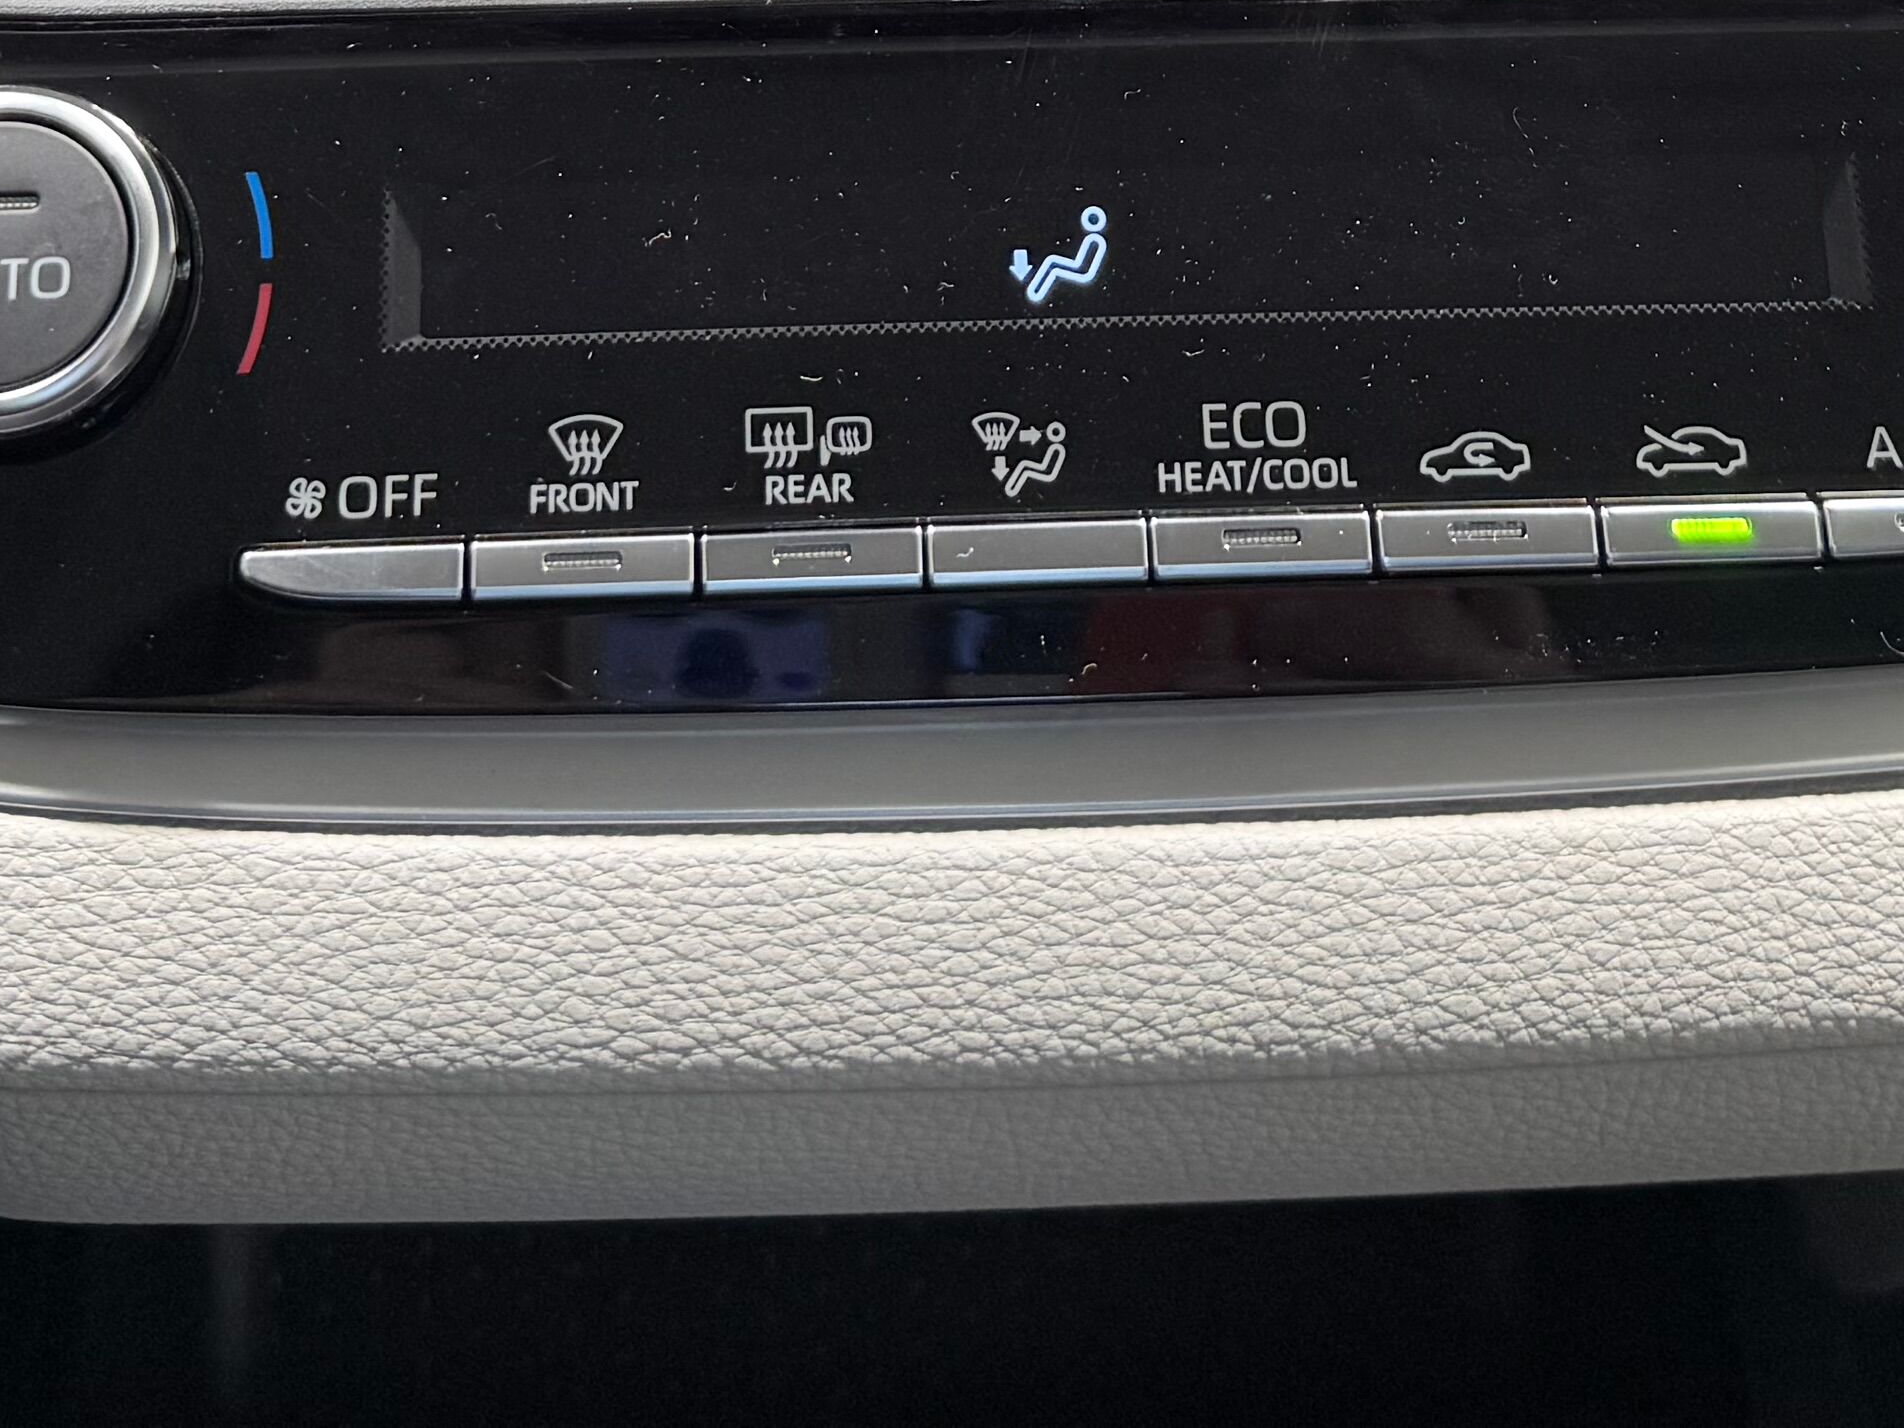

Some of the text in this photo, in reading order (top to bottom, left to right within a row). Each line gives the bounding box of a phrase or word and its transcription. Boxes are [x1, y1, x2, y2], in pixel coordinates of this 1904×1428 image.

[1200, 401, 1308, 451] ECO
[764, 473, 854, 507] REAR
[1157, 455, 1358, 495] HEAT/COOL
[338, 472, 439, 520] OFF
[529, 479, 639, 515] FRONT
